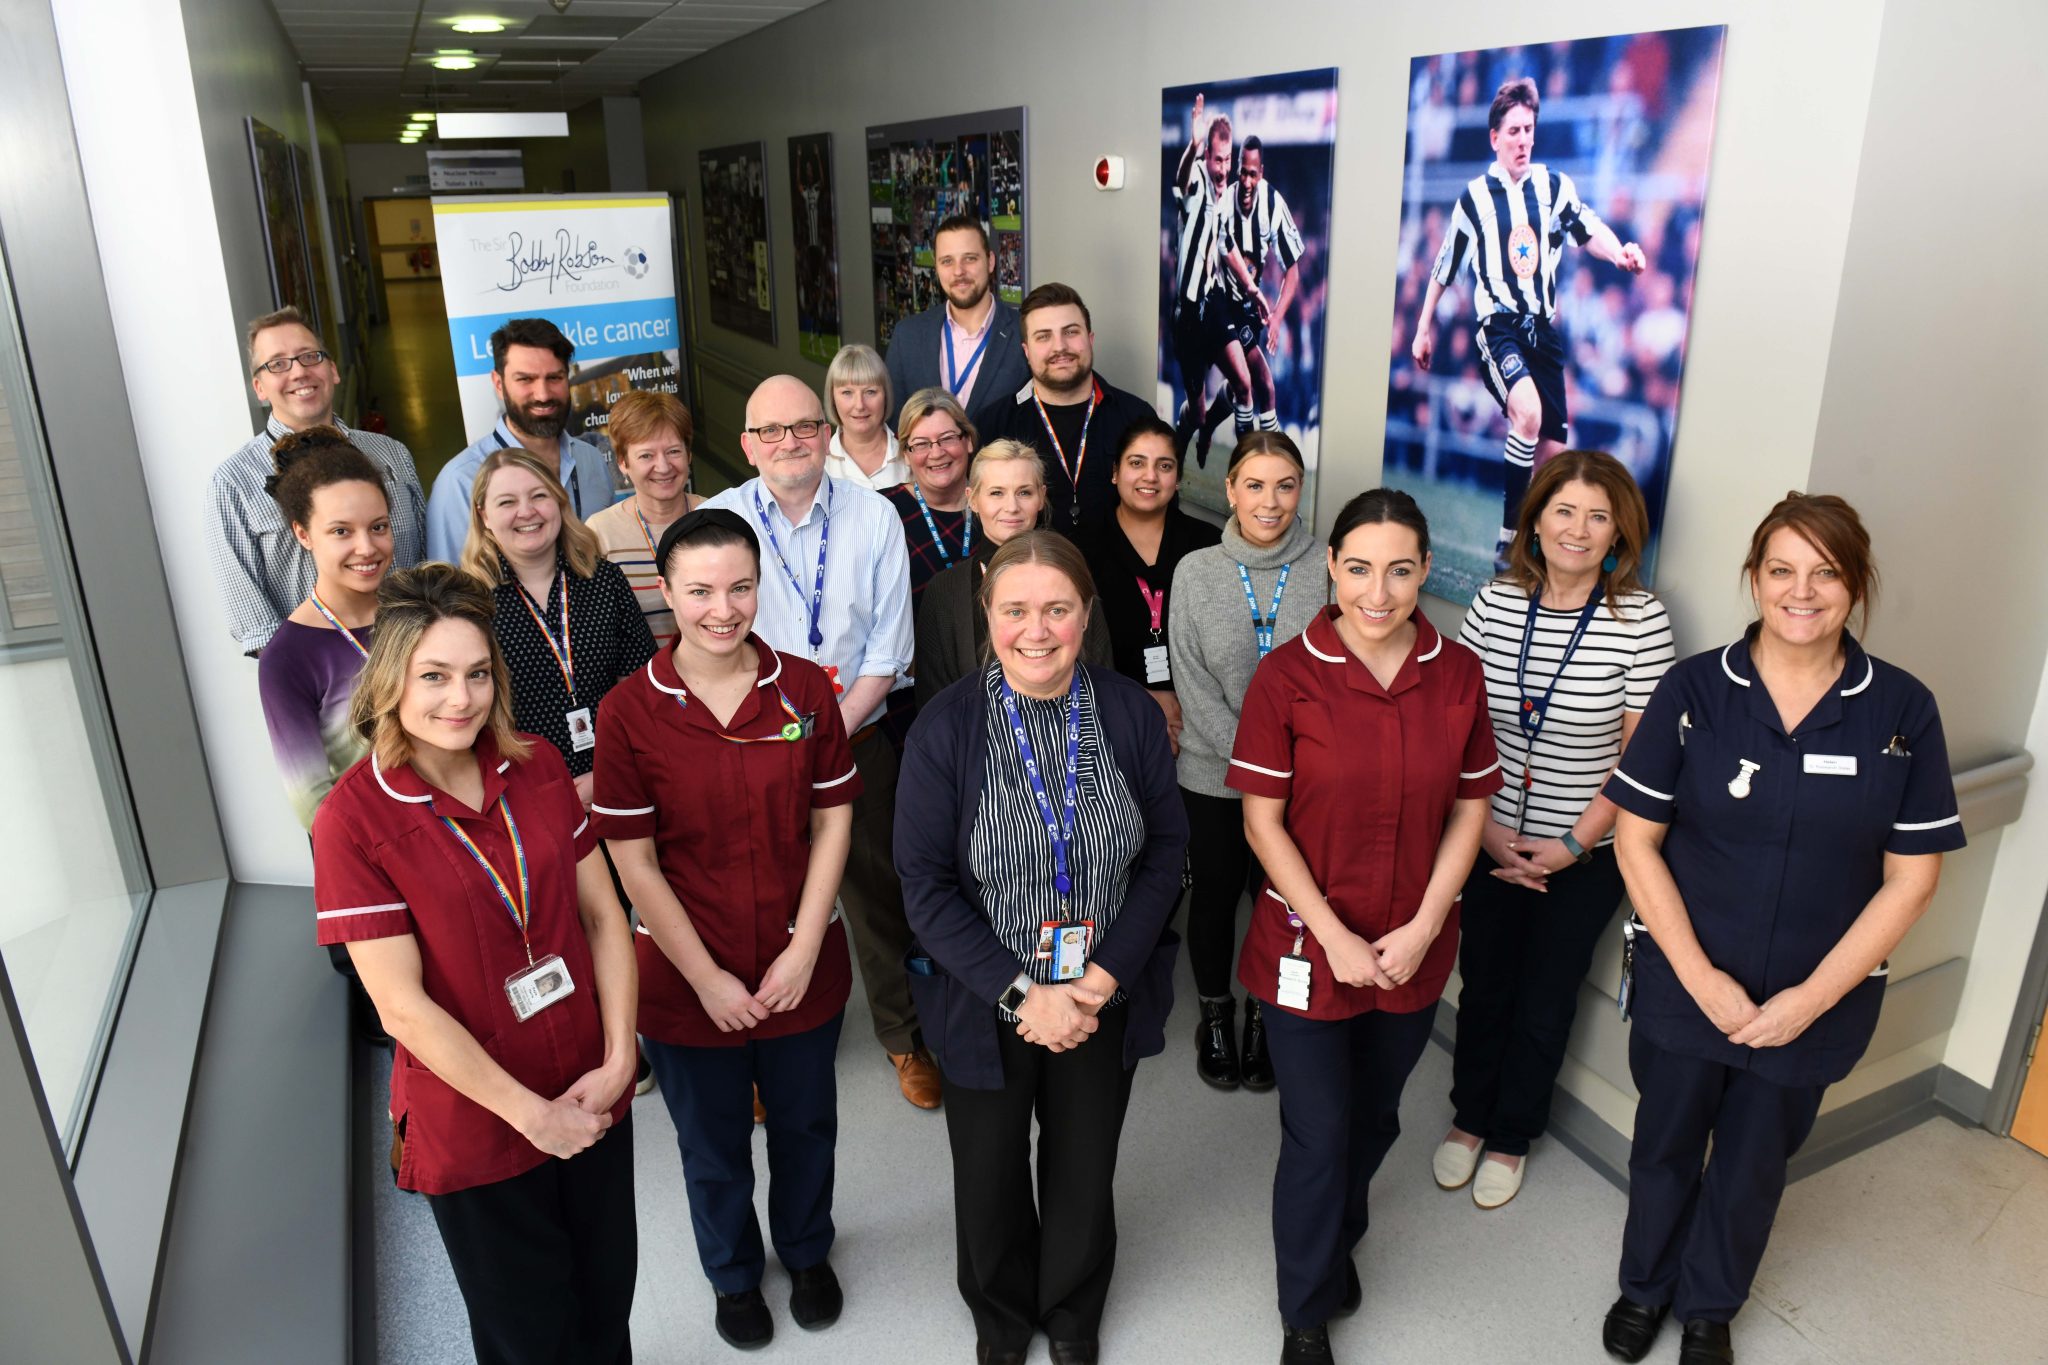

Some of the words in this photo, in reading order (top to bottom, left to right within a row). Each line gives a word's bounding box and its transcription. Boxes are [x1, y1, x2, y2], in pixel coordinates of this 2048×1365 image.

[471, 238, 492, 252] The
[497, 231, 555, 294] Bobby
[555, 229, 615, 281] Robson
[565, 278, 620, 293] Foundation
[603, 318, 671, 343] cancer
[662, 365, 676, 376] we
[661, 381, 678, 394] this
